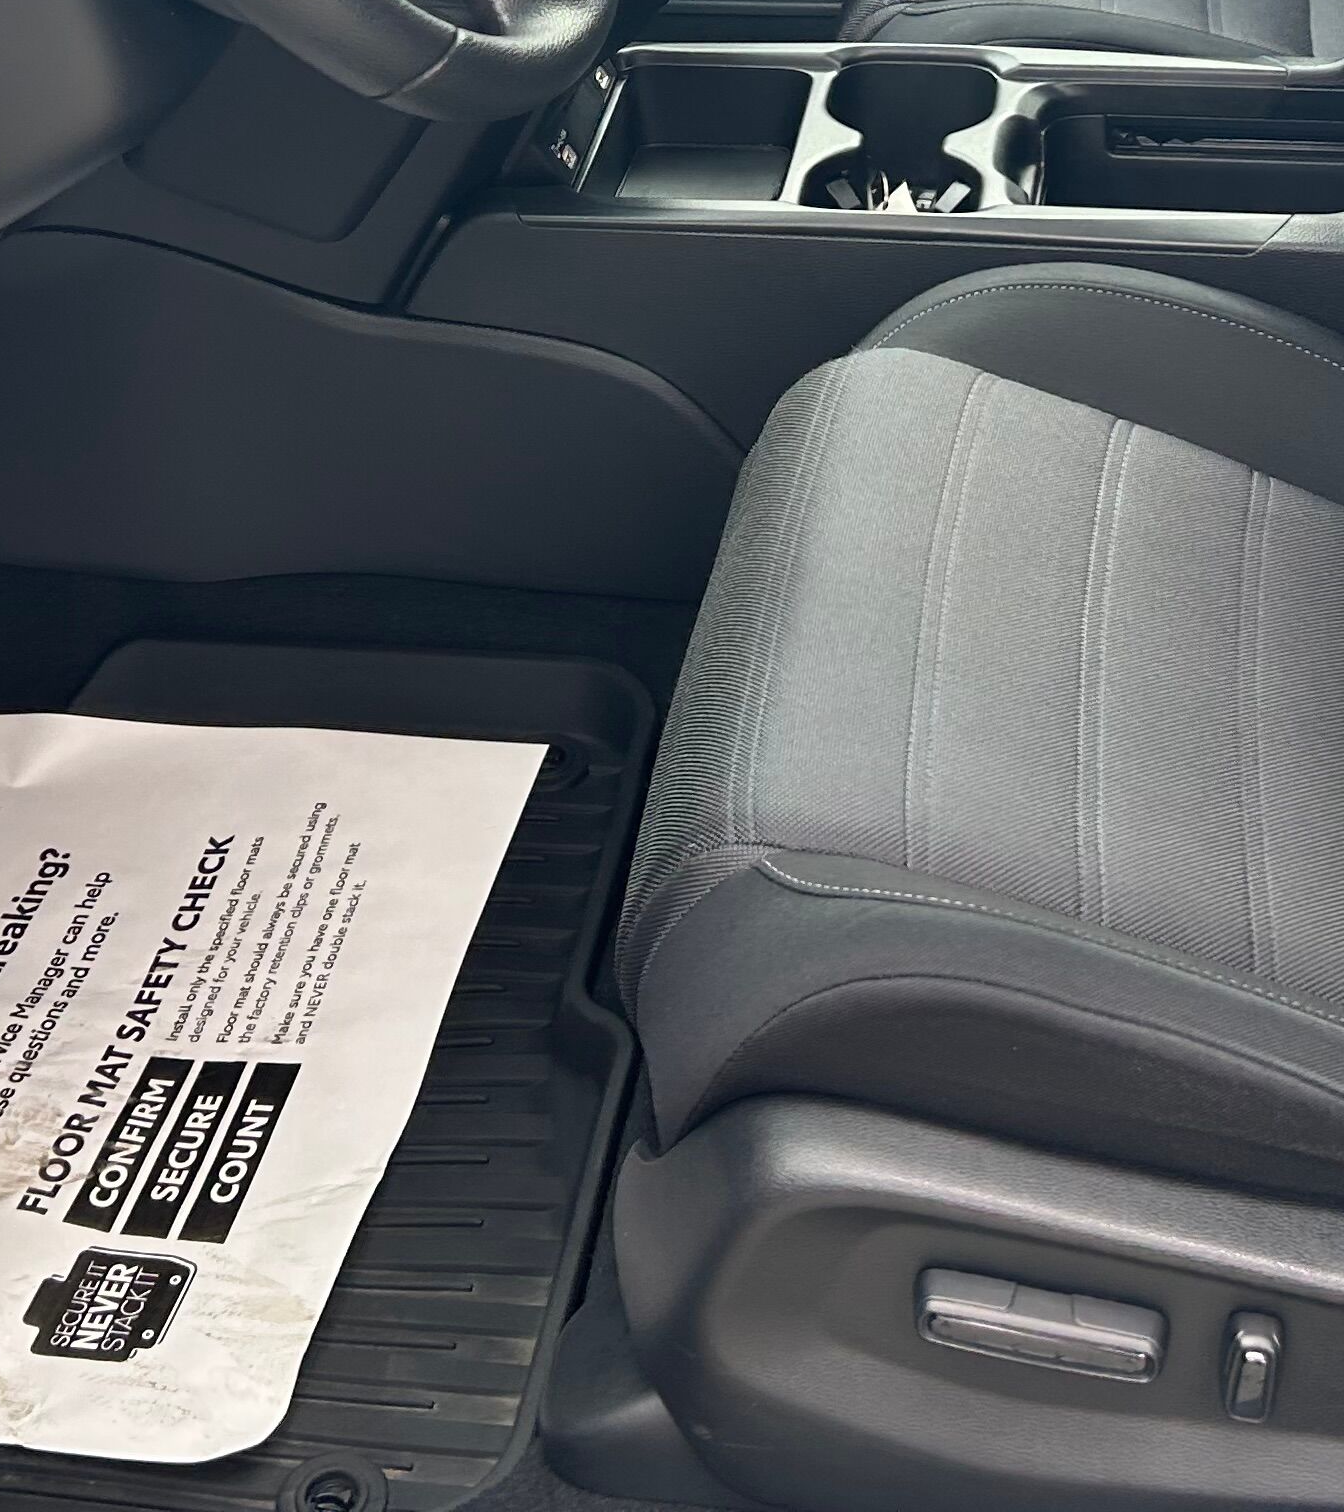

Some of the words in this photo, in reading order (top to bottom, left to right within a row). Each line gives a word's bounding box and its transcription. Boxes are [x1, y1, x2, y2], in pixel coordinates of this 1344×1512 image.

[304, 877, 315, 890] or
[329, 867, 350, 896] floor
[345, 842, 361, 865] mat
[74, 872, 111, 910] help
[323, 898, 339, 920] one
[62, 913, 89, 944] can
[166, 1005, 192, 1042] Install
[187, 976, 206, 1002] only
[197, 954, 214, 974] the
[209, 898, 238, 951] specified
[231, 867, 252, 896] floor
[246, 837, 264, 865] mats
[216, 1007, 239, 1044] Floor
[234, 986, 251, 1009] mat
[245, 943, 269, 983] should
[263, 902, 286, 940] always
[277, 882, 293, 905] be
[287, 836, 311, 879] secured
[307, 802, 327, 832] using
[269, 922, 297, 974] retention
[308, 923, 328, 953] have
[10, 948, 69, 1019] Manager
[190, 986, 221, 1042] designed
[213, 966, 229, 984] for
[224, 937, 241, 963] your
[296, 1021, 312, 1044] and
[304, 972, 330, 1017] NEVER
[322, 927, 347, 970] double
[342, 894, 361, 923] stack
[303, 949, 315, 978] you
[10, 999, 68, 1082] questions
[61, 967, 89, 999] and
[82, 912, 119, 961] more.
[16, 1113, 98, 1215] FLOOR
[77, 1044, 134, 1111] MAT
[116, 937, 188, 1042] SAFETY
[172, 834, 235, 932] CHECK
[246, 977, 277, 1022] factory
[289, 982, 307, 1008] sure
[238, 1018, 257, 1044] the
[272, 1009, 294, 1044] Make
[88, 1078, 175, 1208] CONFIRM
[151, 1094, 223, 1201] SECURE
[210, 1099, 275, 1203] COUNT
[50, 1279, 100, 1347] SECURE
[87, 1260, 107, 1276] IT
[70, 1263, 139, 1350] NEVER
[101, 1288, 152, 1351] STACK
[134, 1266, 158, 1285] IT
